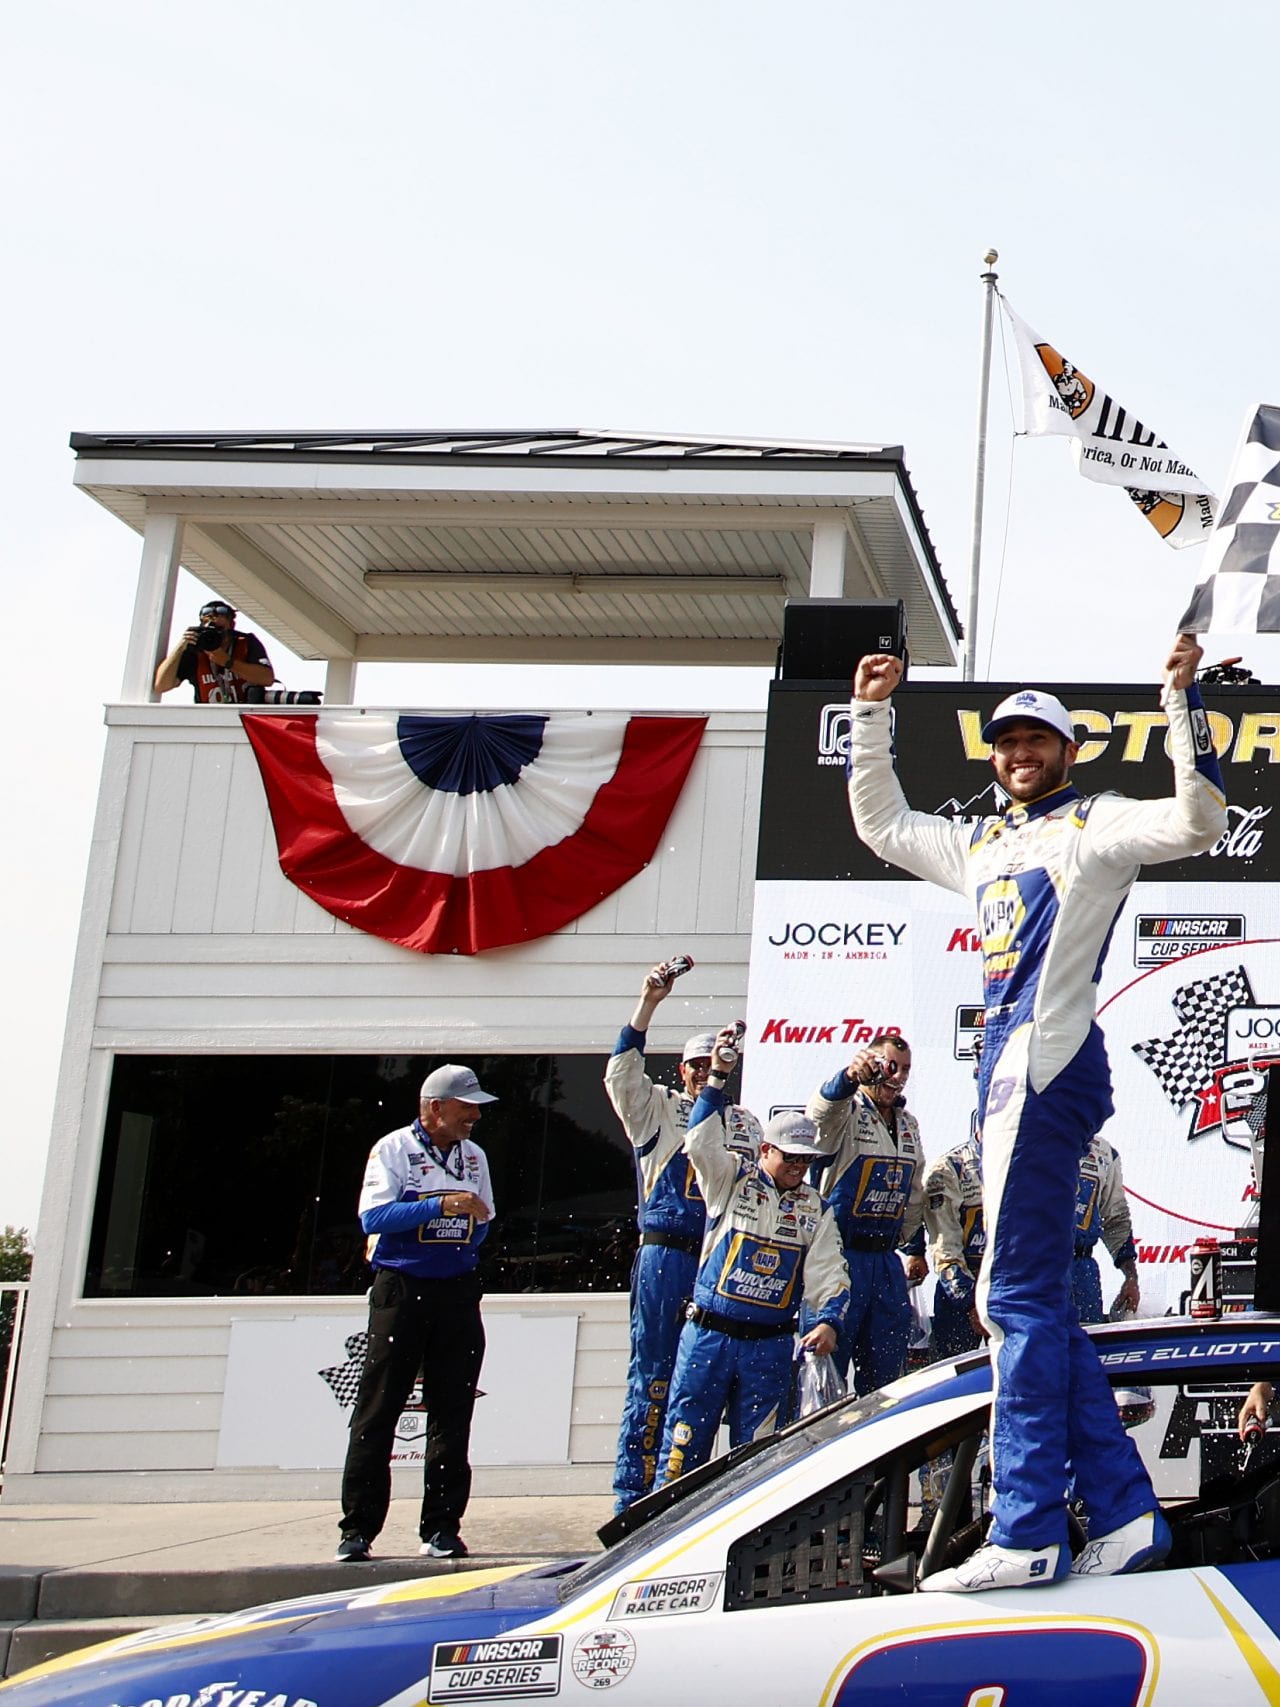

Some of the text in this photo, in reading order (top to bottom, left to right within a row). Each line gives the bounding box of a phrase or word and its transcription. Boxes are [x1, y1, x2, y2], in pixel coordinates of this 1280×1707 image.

[1083, 447, 1116, 467] rica,
[1120, 452, 1137, 468] Or
[1140, 457, 1163, 473] Not
[818, 756, 846, 766] ROAD
[769, 923, 907, 946] JOCKEY
[1171, 920, 1229, 935] NASCAR
[784, 951, 887, 960] MADE IN AMERICA
[1151, 943, 1179, 956] CUP
[436, 1229, 462, 1239] CENTER
[1132, 1239, 1193, 1263] WIK
[756, 1252, 778, 1269] NAPA
[736, 1284, 772, 1301] CENTER
[1152, 1341, 1280, 1361] ELLIOTT
[1028, 1557, 1047, 1578] 9
[648, 1578, 707, 1599] NASCAR
[624, 1596, 701, 1615] RACE CAR
[474, 1640, 543, 1662] NASCAR
[588, 1647, 624, 1660] WINS
[578, 1657, 629, 1671] RECORD
[448, 1666, 541, 1688] CUP SERIES
[594, 1678, 610, 1687] 269
